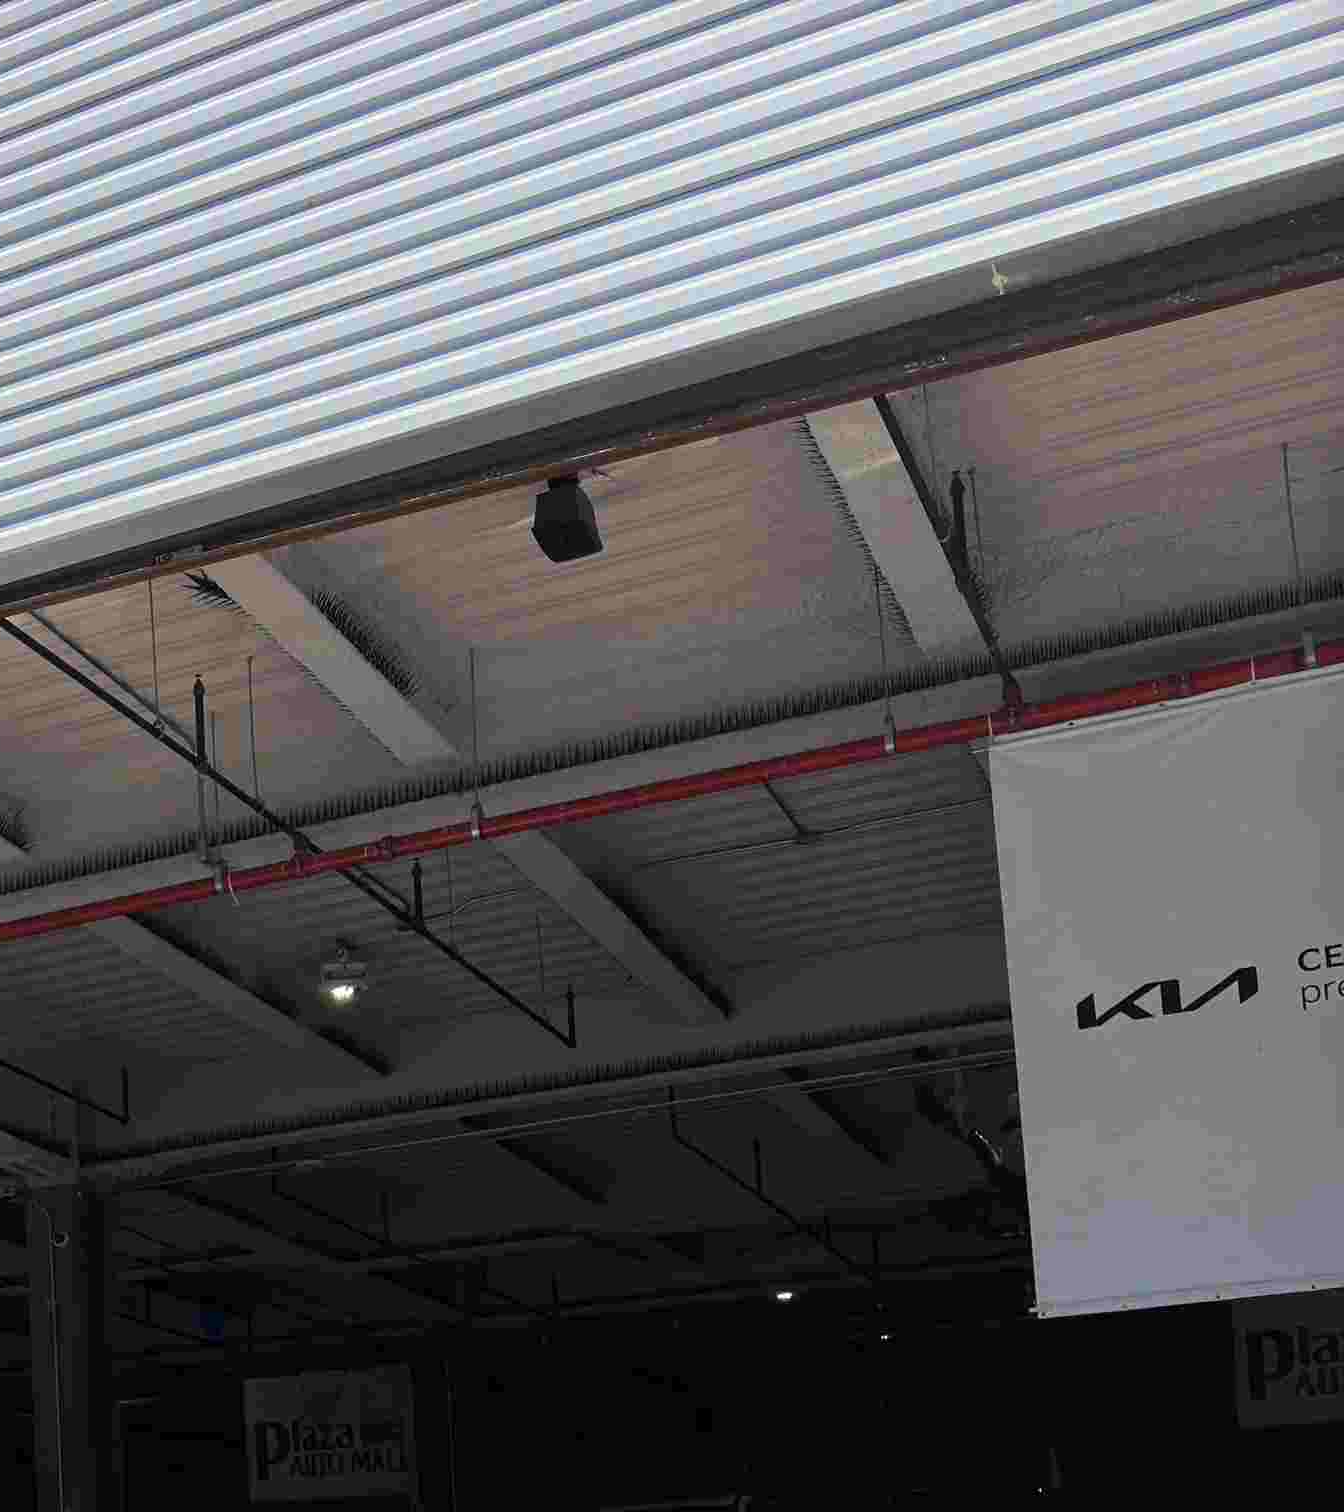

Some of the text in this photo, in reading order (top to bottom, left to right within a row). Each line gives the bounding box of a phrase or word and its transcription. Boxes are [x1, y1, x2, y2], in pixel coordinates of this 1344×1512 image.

[1297, 943, 1344, 972] CE
[1075, 964, 1258, 1030] KIA
[1248, 1326, 1344, 1401] Pla
[1294, 1365, 1344, 1397] AU
